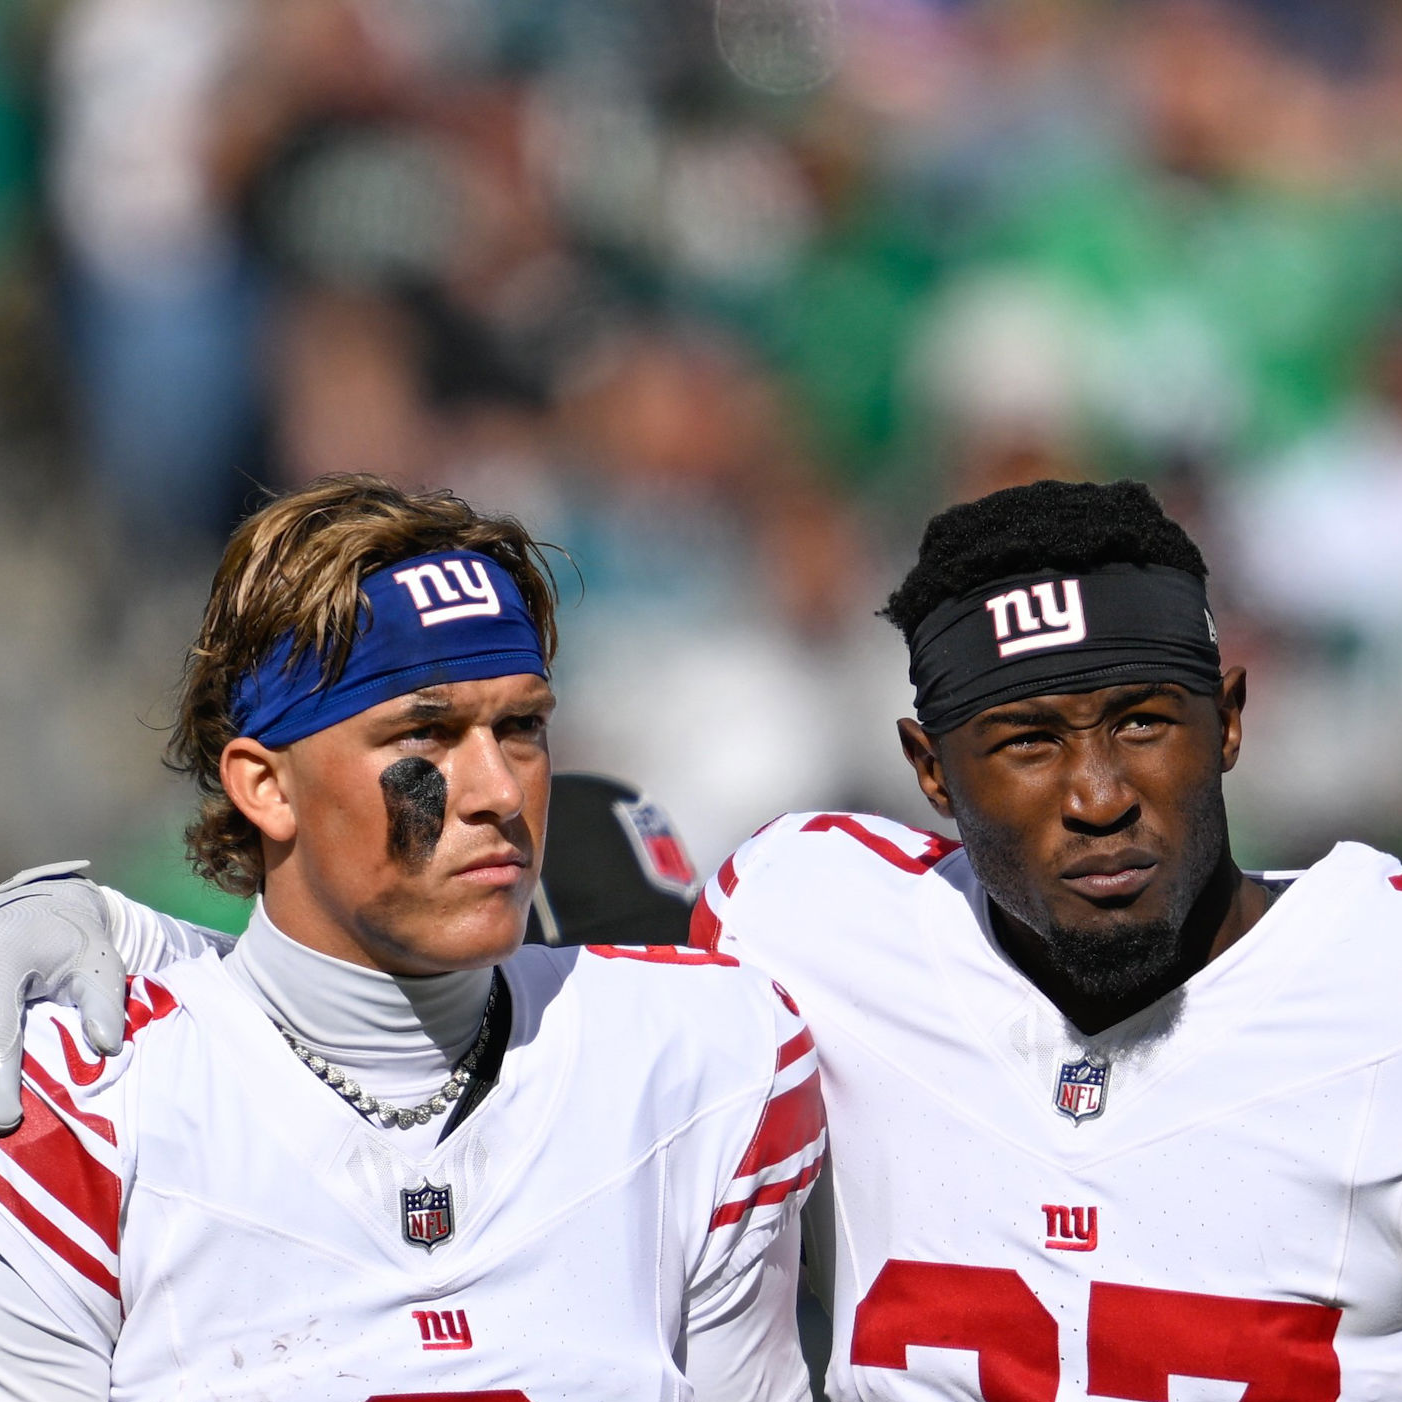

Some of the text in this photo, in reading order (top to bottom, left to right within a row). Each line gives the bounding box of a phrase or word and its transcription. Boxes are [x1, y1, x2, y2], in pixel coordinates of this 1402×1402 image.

[392, 558, 502, 628] ny
[985, 578, 1088, 658] ny
[1060, 1083, 1098, 1114] NFL
[409, 1210, 448, 1241] NFL
[1041, 1203, 1099, 1252] ny
[411, 1308, 473, 1351] ny
